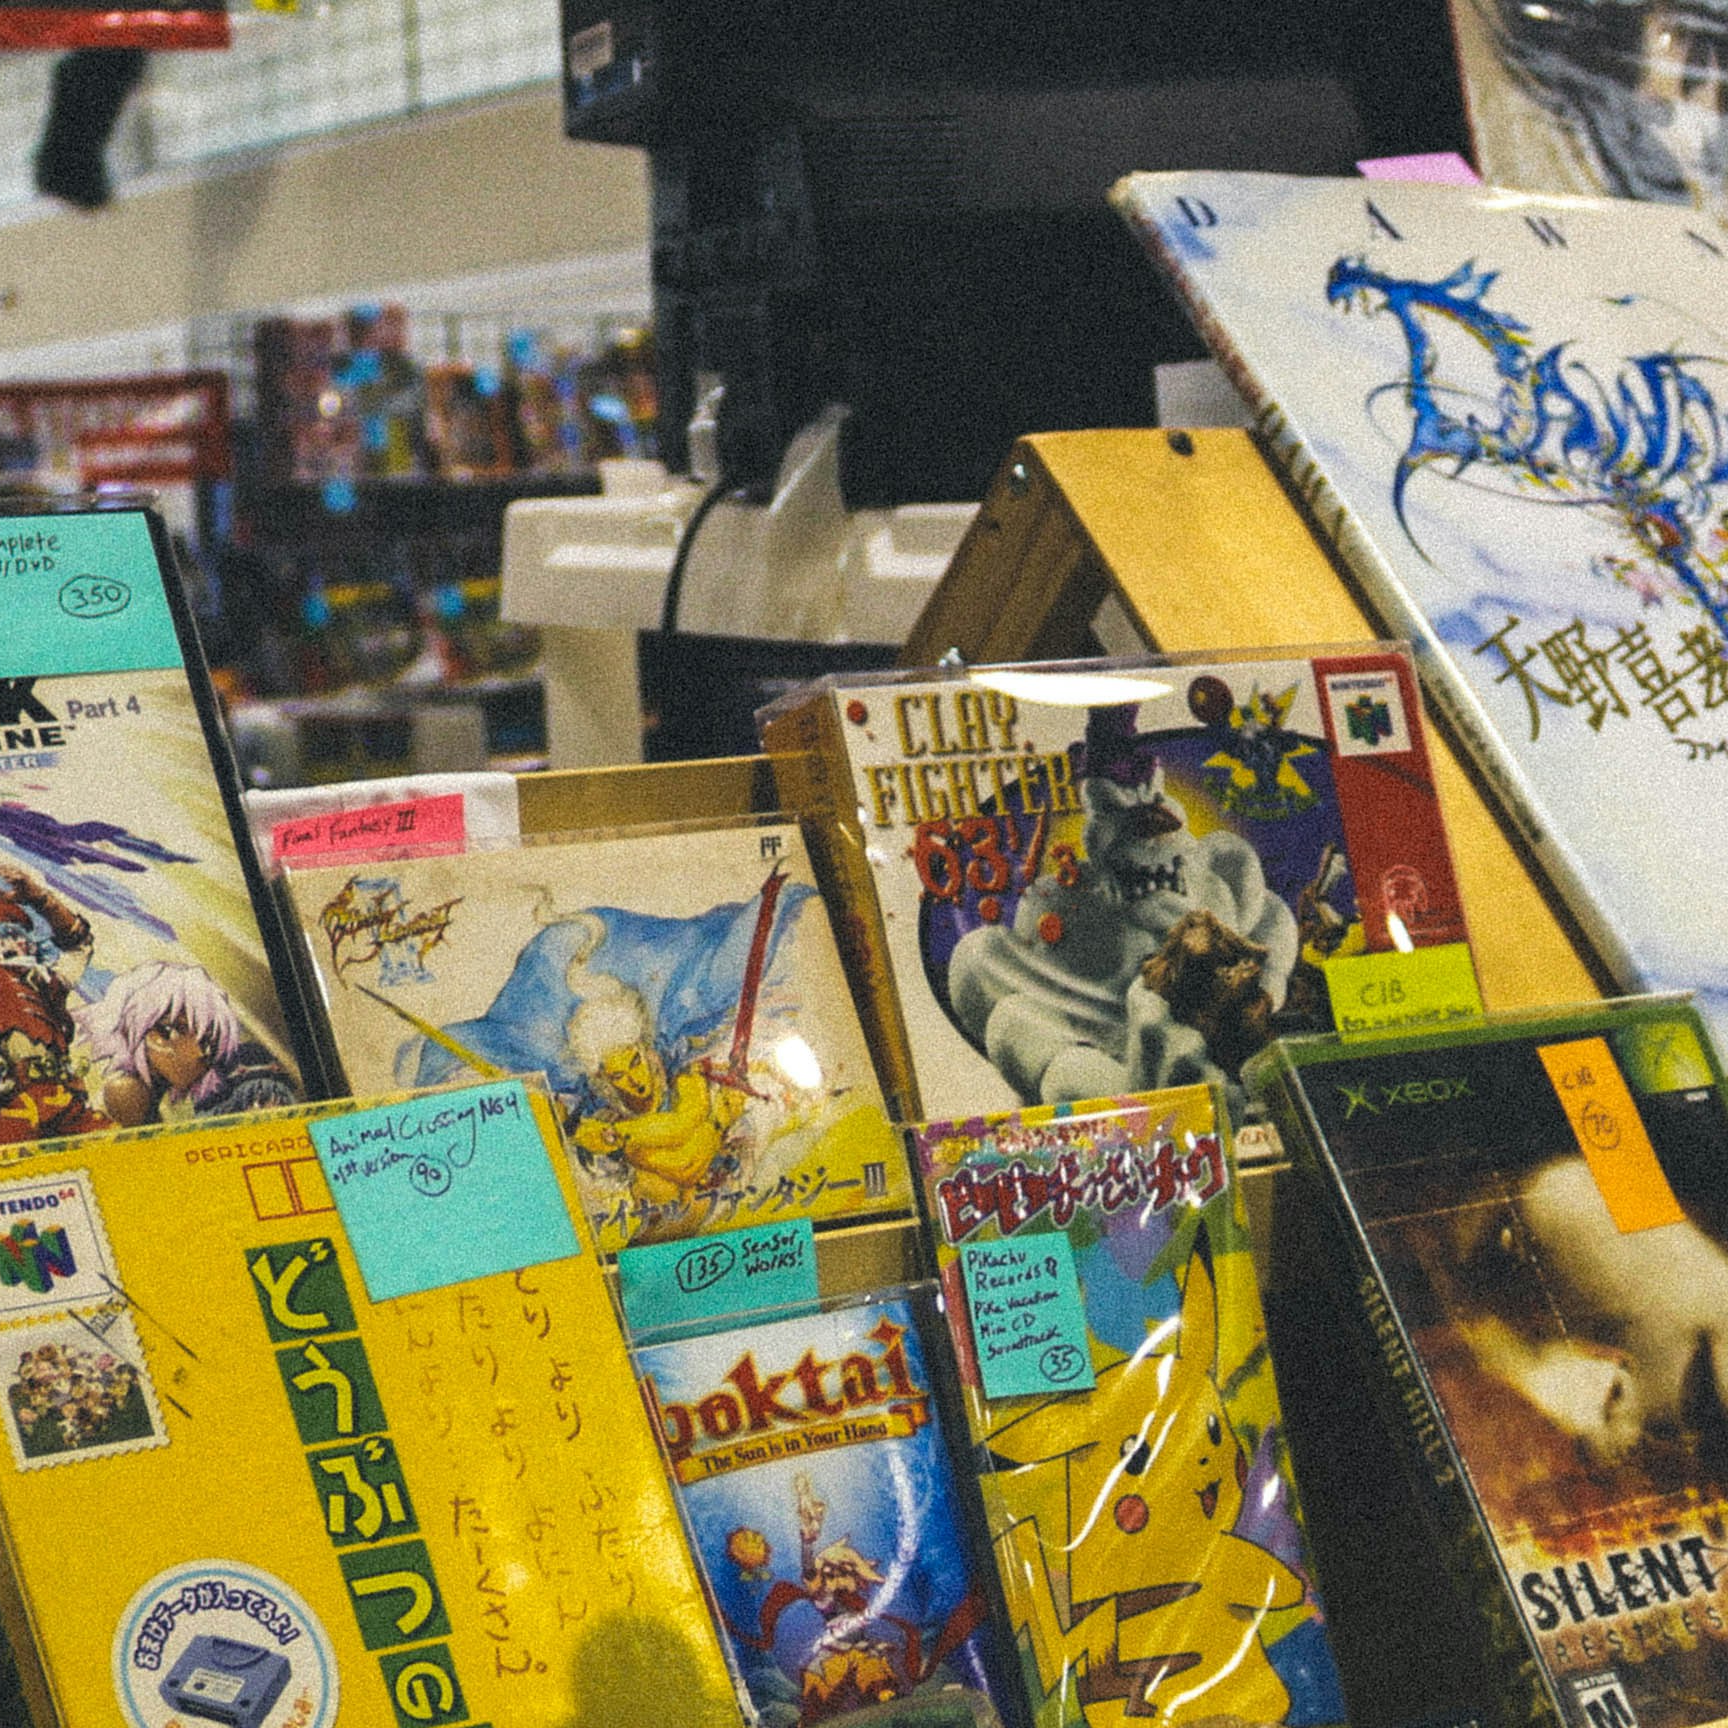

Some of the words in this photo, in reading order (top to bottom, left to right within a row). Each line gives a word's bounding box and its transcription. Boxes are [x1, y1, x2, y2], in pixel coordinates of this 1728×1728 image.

[69, 582, 124, 611] 350
[67, 698, 113, 720] Part
[124, 693, 142, 715] 4
[893, 689, 1020, 758] CLAY
[864, 751, 1084, 829] FIGHTER
[282, 827, 321, 851] Final
[329, 816, 393, 846] Fantasy
[328, 1115, 396, 1158] Animal
[478, 1090, 522, 1123] N64
[414, 1159, 443, 1187] 90
[685, 1250, 724, 1284] 135
[741, 1229, 799, 1258] Sensor
[966, 1248, 1027, 1274] Pikachu
[1011, 1312, 1037, 1332] CD
[1049, 1346, 1075, 1373] 35
[700, 1453, 732, 1476] The
[735, 1442, 764, 1463] Sun
[768, 1439, 783, 1455] is
[784, 1436, 800, 1453] in
[801, 1426, 841, 1448] Your
[843, 1418, 888, 1440] Hand
[1521, 1536, 1718, 1631] SILENT
